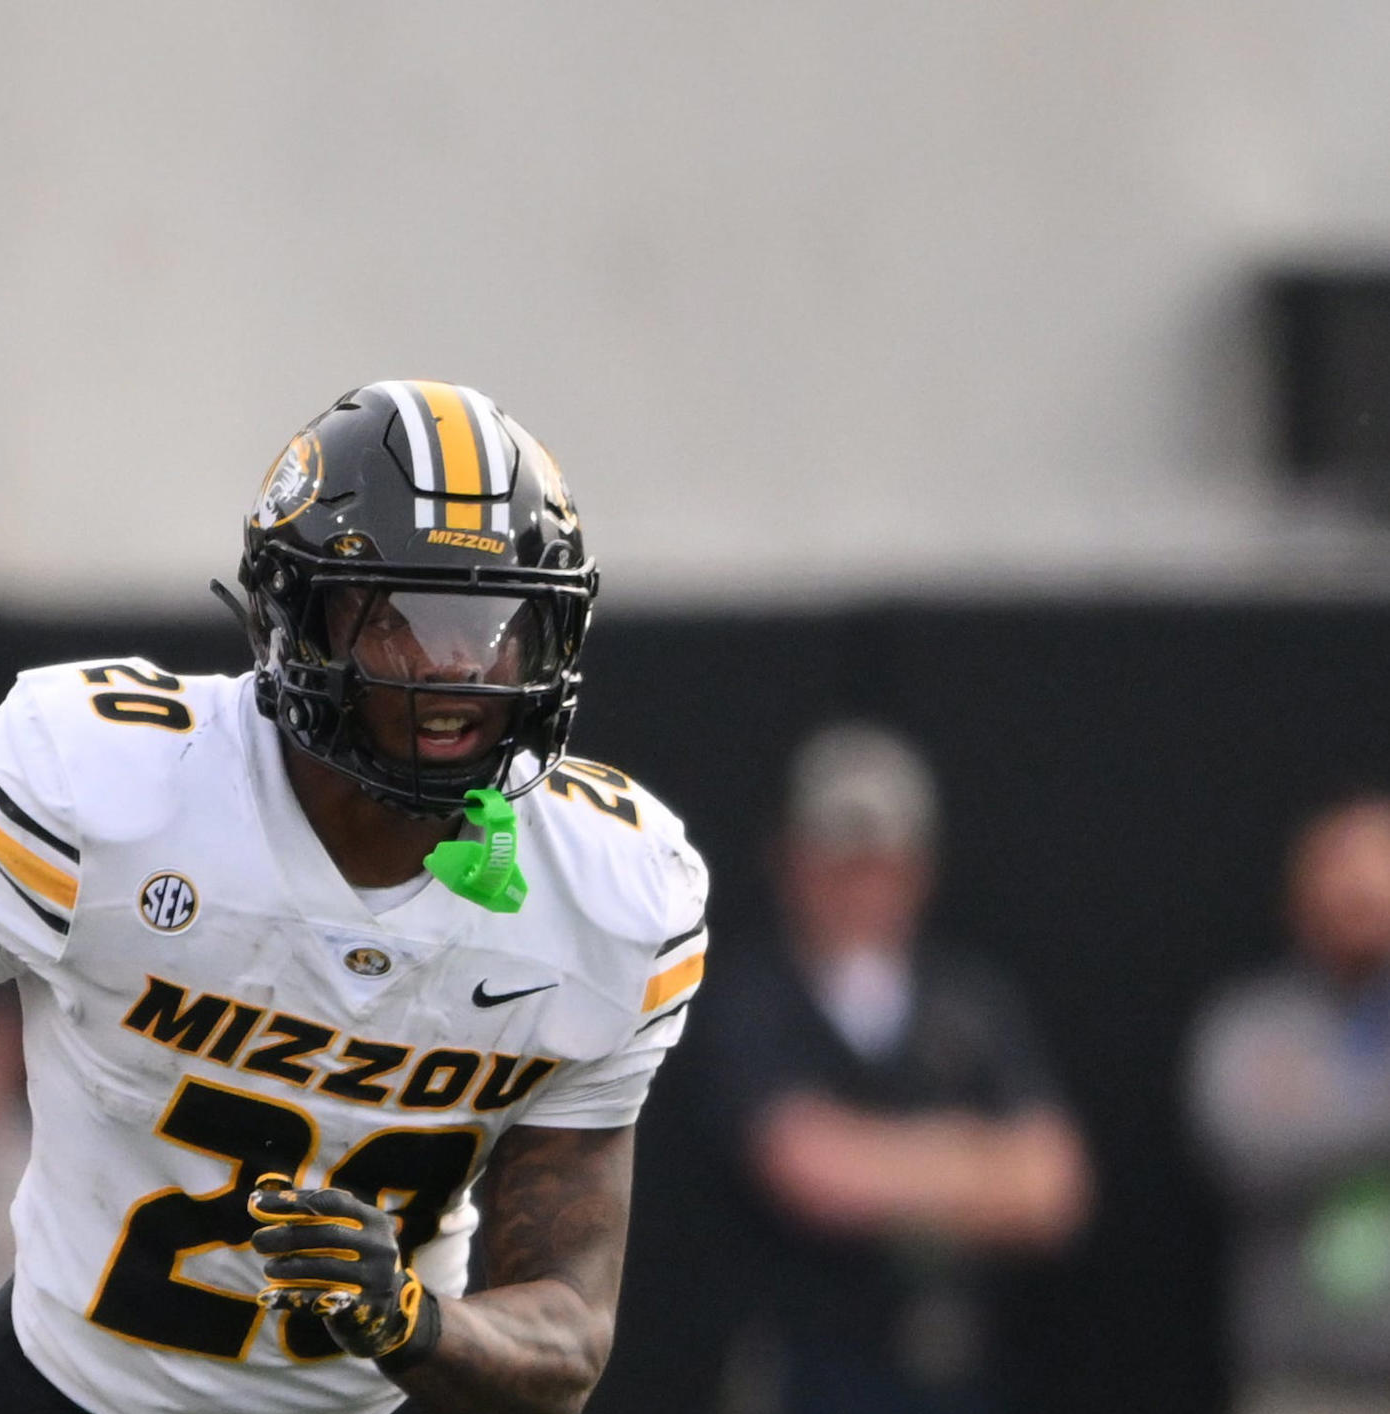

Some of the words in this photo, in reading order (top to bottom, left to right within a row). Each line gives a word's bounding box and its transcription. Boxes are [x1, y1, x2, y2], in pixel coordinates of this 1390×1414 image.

[426, 529, 506, 555] MIZZOU
[142, 876, 194, 929] SEC
[121, 974, 561, 1115] MIZZOU
